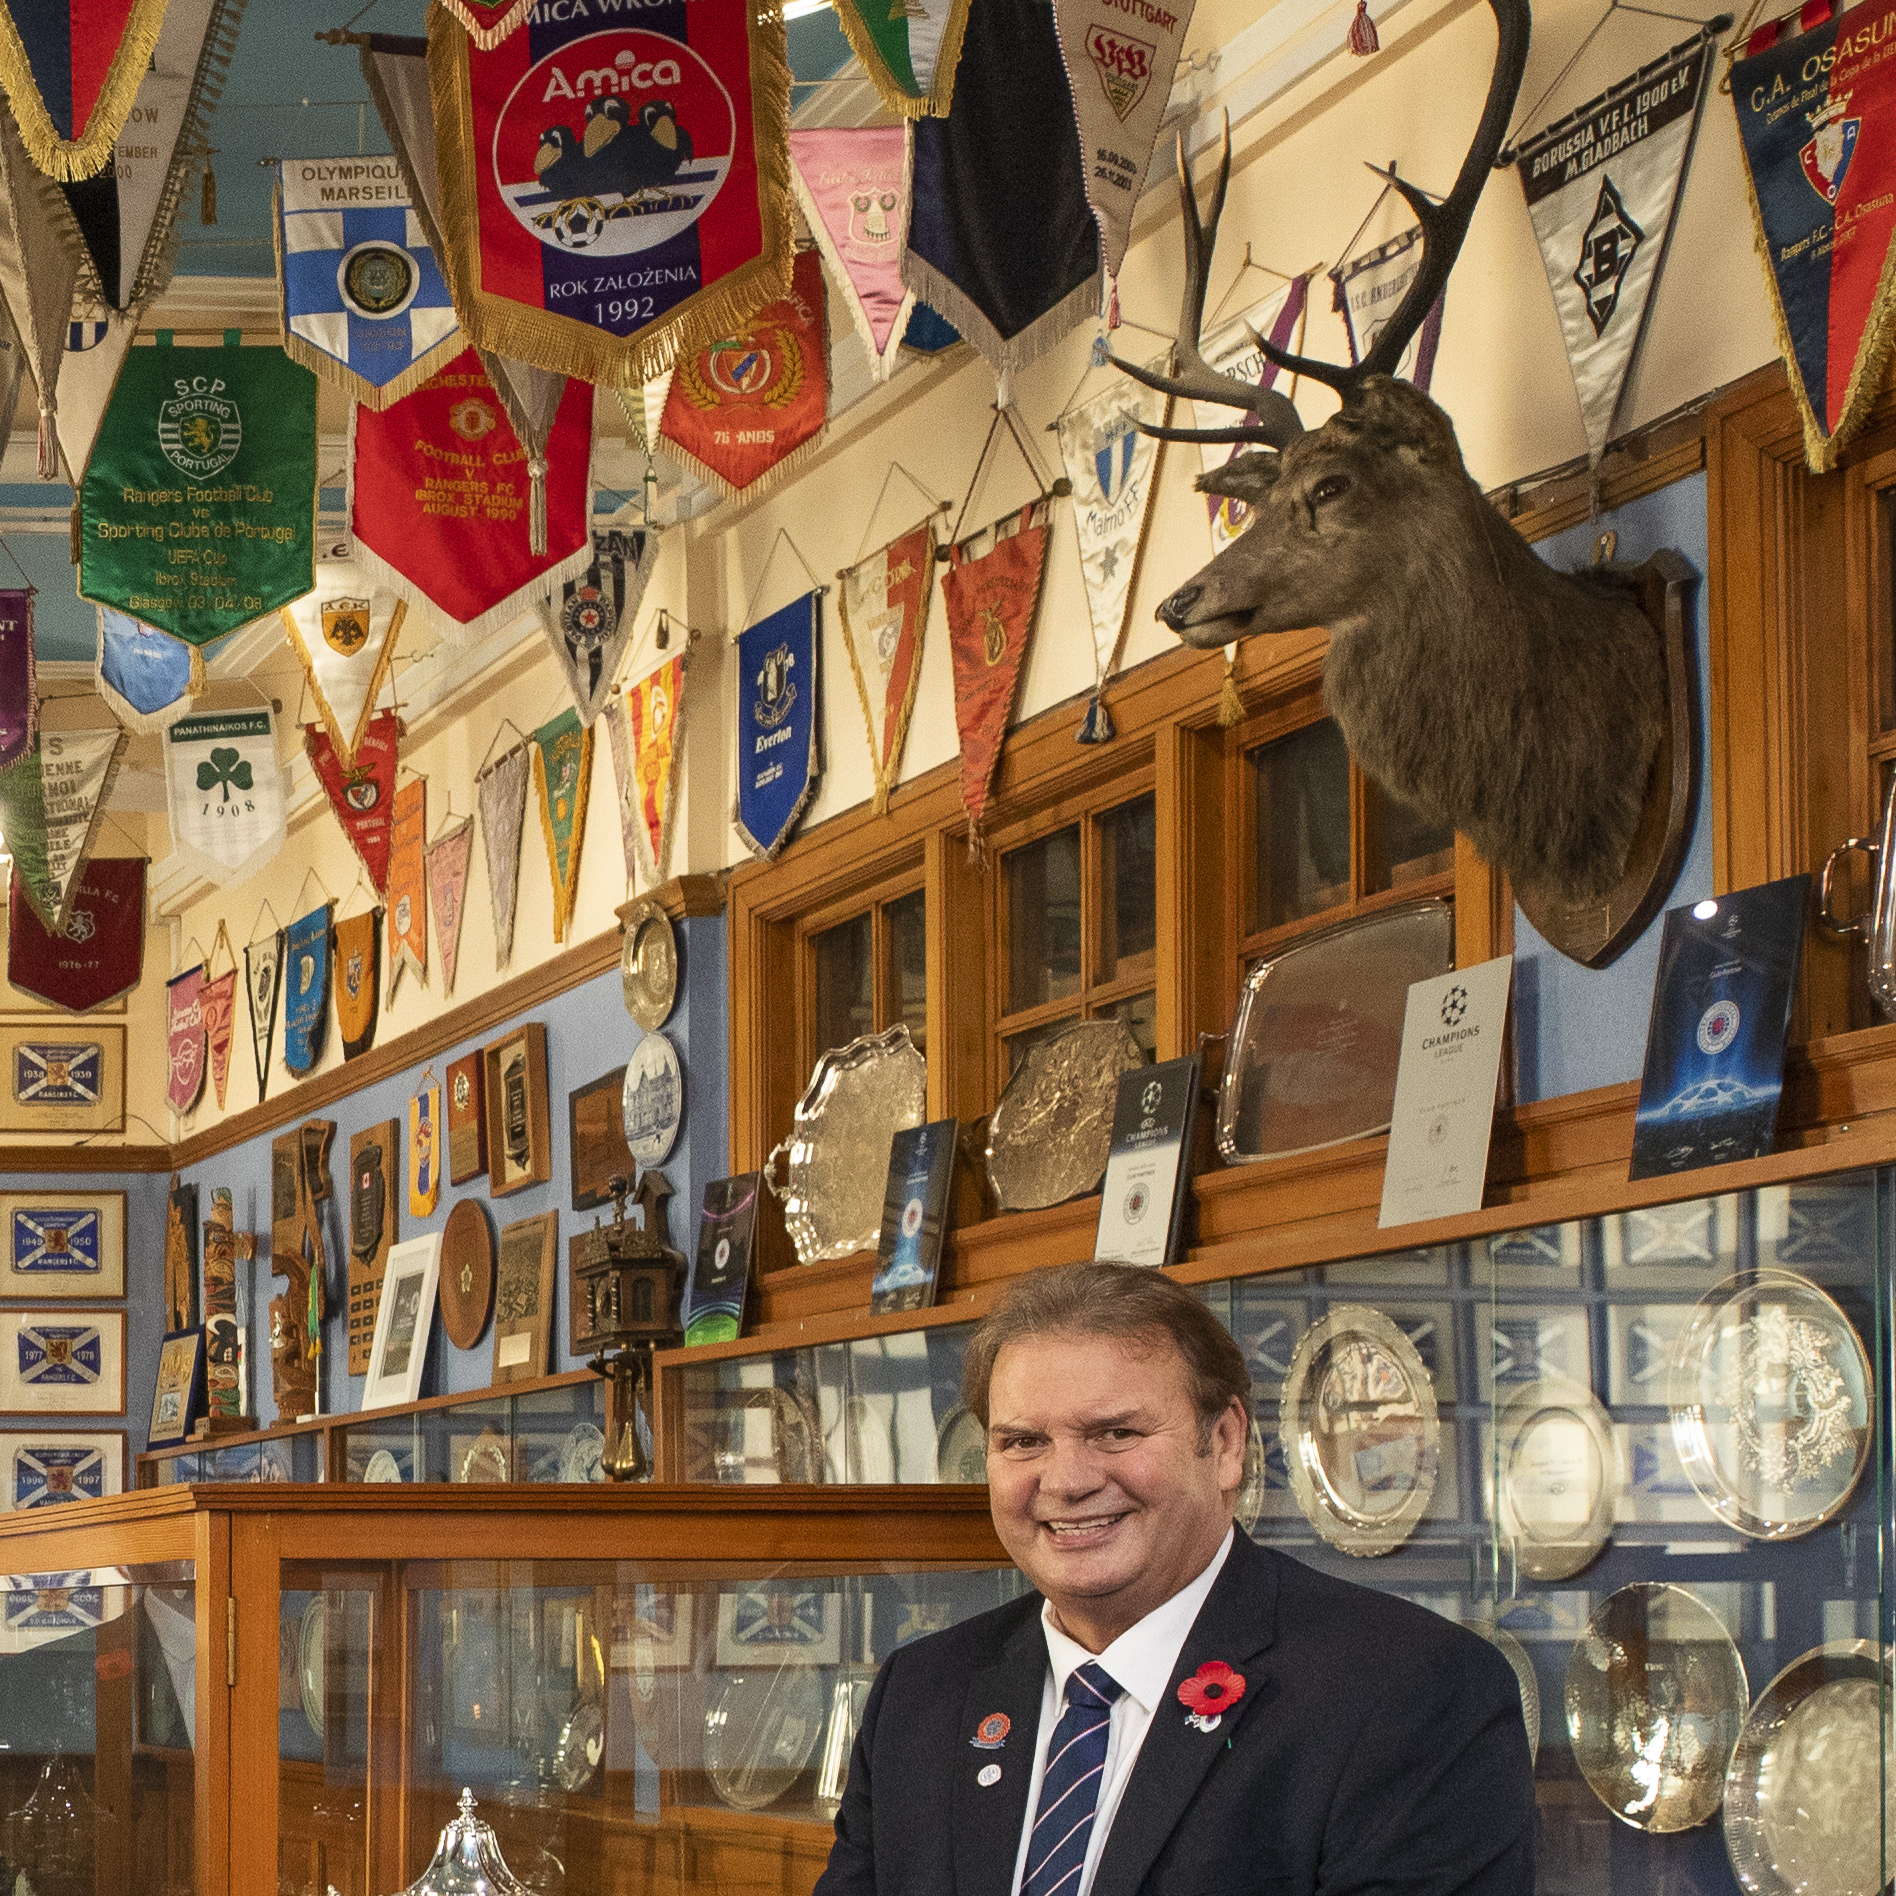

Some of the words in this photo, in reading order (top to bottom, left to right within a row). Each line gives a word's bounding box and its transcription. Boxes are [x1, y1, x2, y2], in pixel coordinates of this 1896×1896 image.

[543, 51, 681, 102] Amica
[1532, 127, 1595, 179] BORUSSIA
[1597, 109, 1635, 143] V.F.L.
[1636, 84, 1669, 121] 1900
[1565, 117, 1649, 181] M.GLADBACH
[301, 163, 406, 182] OLYMPIQU
[320, 185, 405, 203] MARSEIL
[550, 280, 590, 299] ROK
[594, 297, 655, 325] 1992
[175, 376, 226, 396] SCP
[168, 399, 231, 420] SPORTING
[169, 450, 233, 472] PORTUGAL
[123, 487, 184, 507] Rangers
[187, 487, 246, 503] Football
[174, 720, 246, 737] PANATHINAIKOS
[755, 725, 792, 756] Everton
[201, 799, 256, 819] 1908
[1422, 1025, 1481, 1051] CHAMPIONS
[1434, 1043, 1464, 1059] LEAGUE
